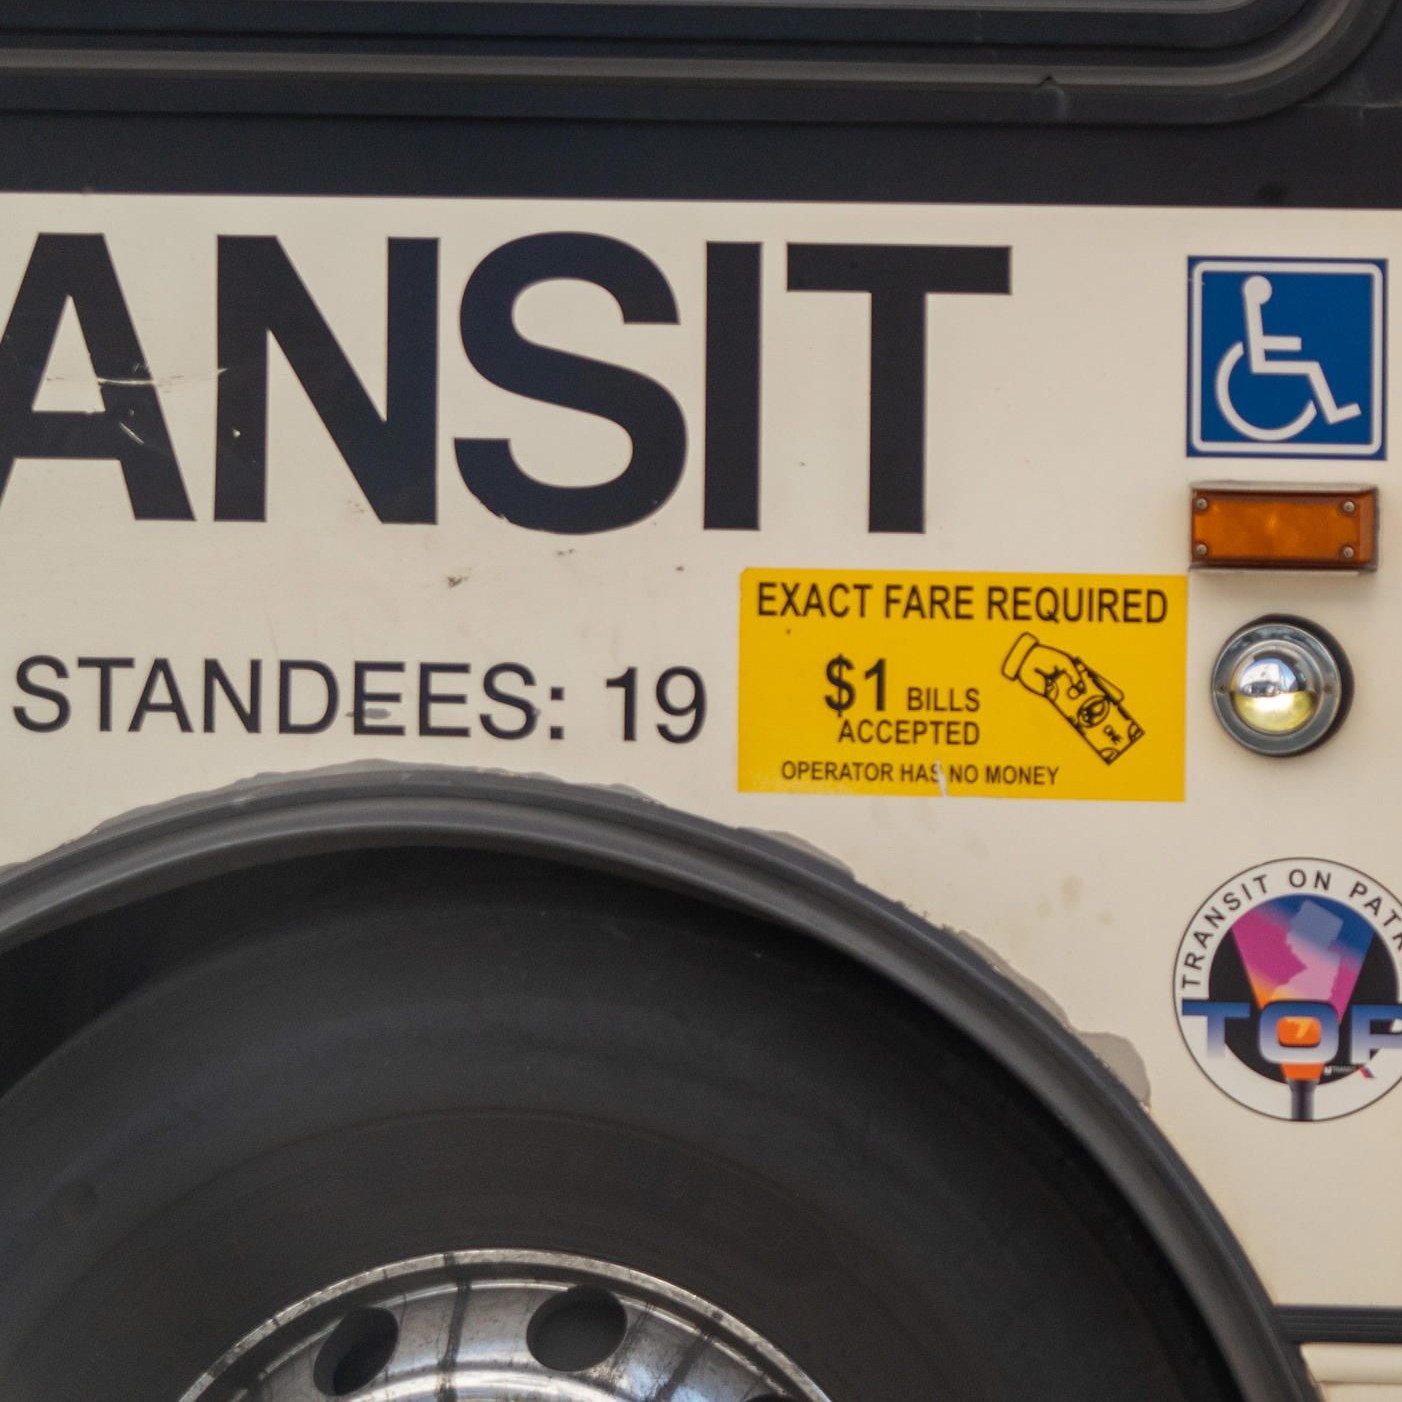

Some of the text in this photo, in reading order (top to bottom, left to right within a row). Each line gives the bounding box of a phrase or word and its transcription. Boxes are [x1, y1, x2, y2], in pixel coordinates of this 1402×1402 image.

[0, 231, 1013, 534] ANSIT
[757, 582, 1168, 624] EXACT FARE REQUIRED
[12, 655, 708, 744] STANDEES: 19
[825, 653, 980, 717] $1 BILLS
[838, 720, 980, 745] ACCEPTED
[781, 760, 1060, 786] OPERATOR HAS NO MONEY
[1182, 874, 1268, 989] TRANSIT
[1288, 869, 1331, 891] ON
